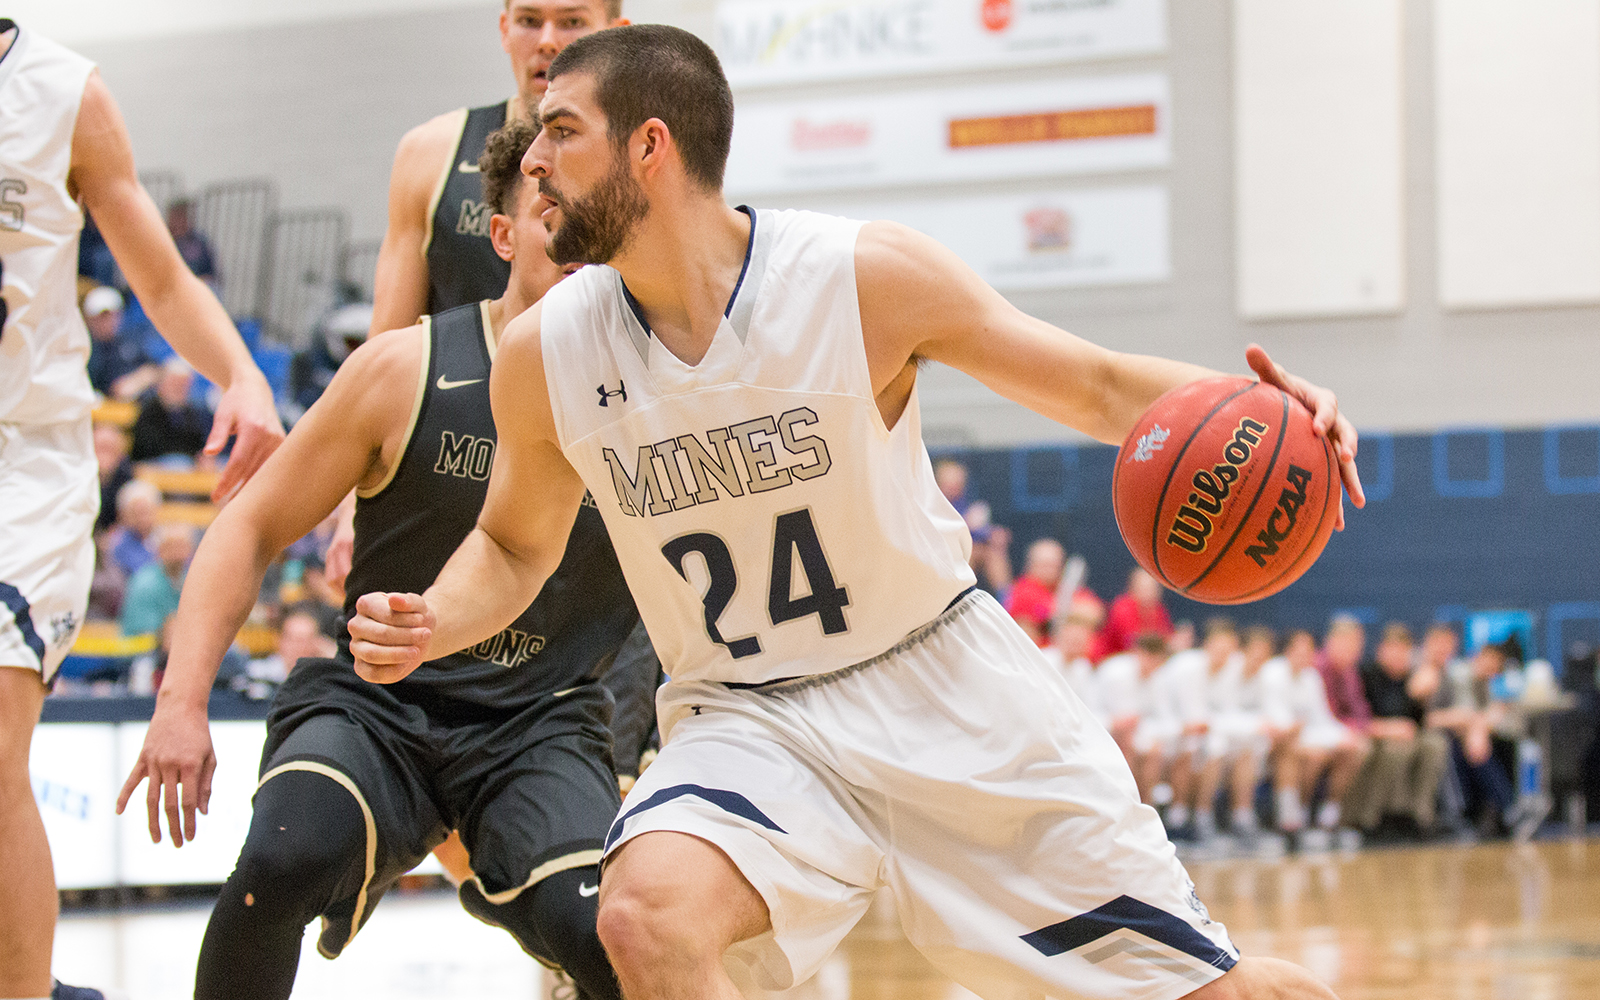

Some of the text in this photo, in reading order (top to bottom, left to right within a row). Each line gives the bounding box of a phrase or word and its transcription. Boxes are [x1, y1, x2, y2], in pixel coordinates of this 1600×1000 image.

[602, 406, 832, 518] MINES
[1165, 416, 1269, 554] Wilson
[1244, 464, 1312, 568] NCAA
[659, 504, 854, 660] 24
